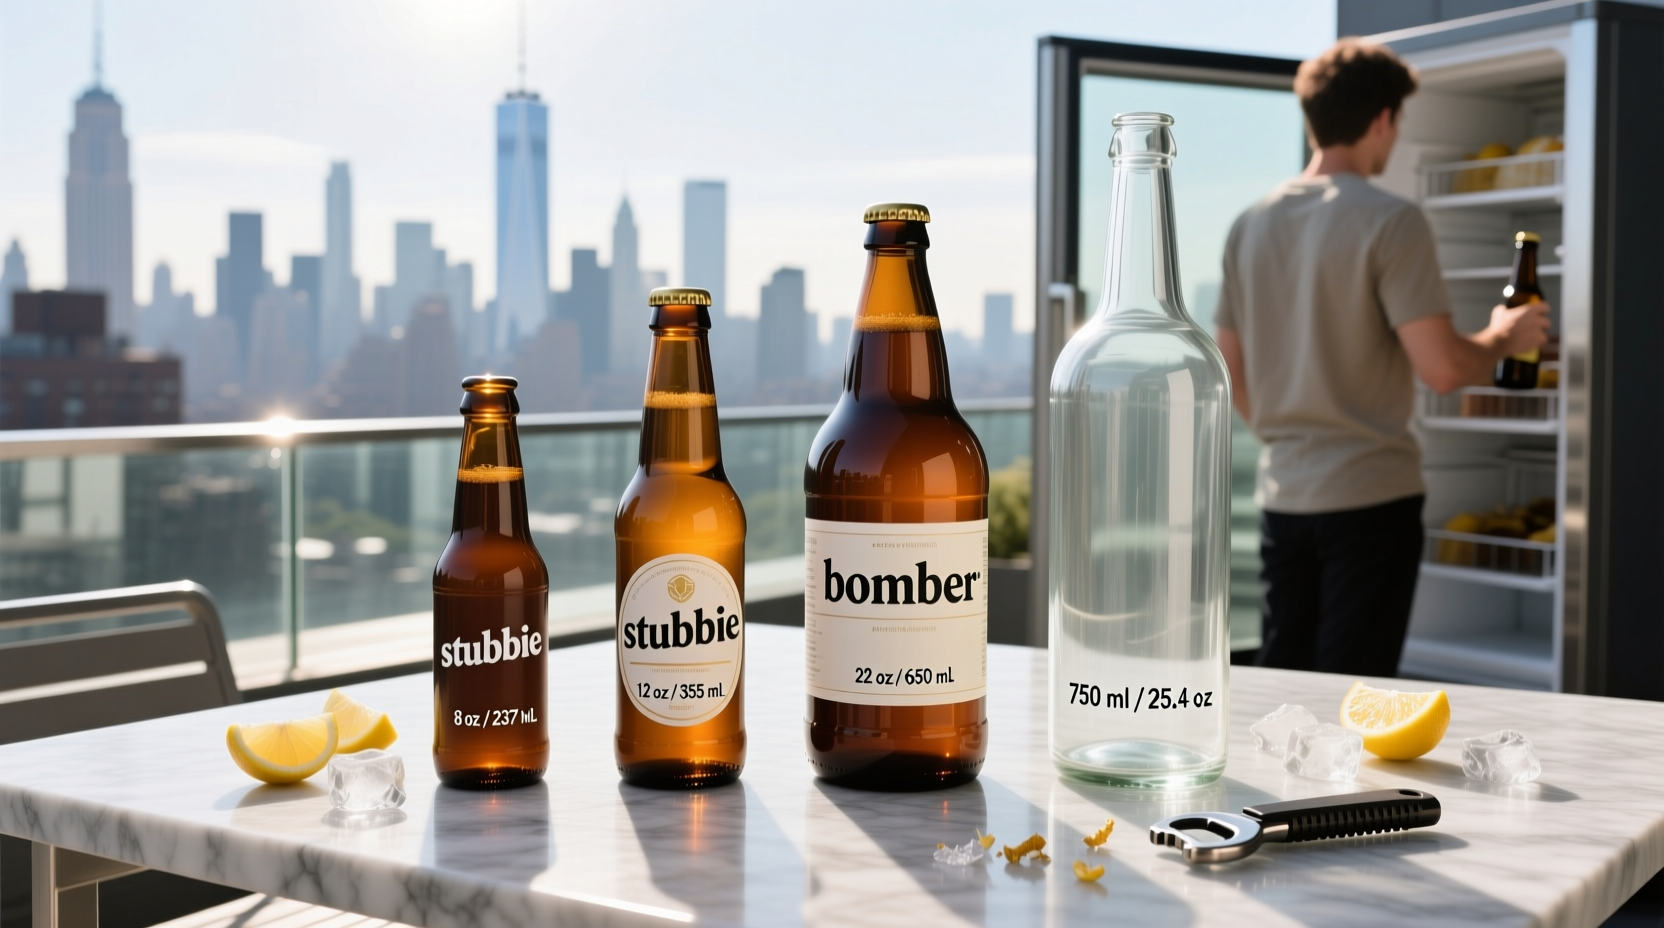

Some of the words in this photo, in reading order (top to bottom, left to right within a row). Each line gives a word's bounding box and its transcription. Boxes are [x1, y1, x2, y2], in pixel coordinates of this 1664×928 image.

[823, 557, 977, 605] bomber
[623, 605, 740, 650] stubbie
[441, 624, 542, 668] stubbie
[855, 667, 873, 684] 22
[876, 673, 894, 685] oz
[905, 668, 933, 685] 650
[936, 666, 955, 684] mL
[637, 683, 651, 698] 12
[653, 688, 670, 700] oz
[679, 683, 705, 700] 355
[708, 682, 726, 698] mL
[1069, 682, 1101, 707] 750
[1107, 687, 1129, 709] ml
[1148, 687, 1190, 709] 25.4
[1193, 691, 1213, 708] oz
[454, 709, 462, 726] 8
[464, 715, 481, 727] oz
[492, 709, 519, 726] 237
